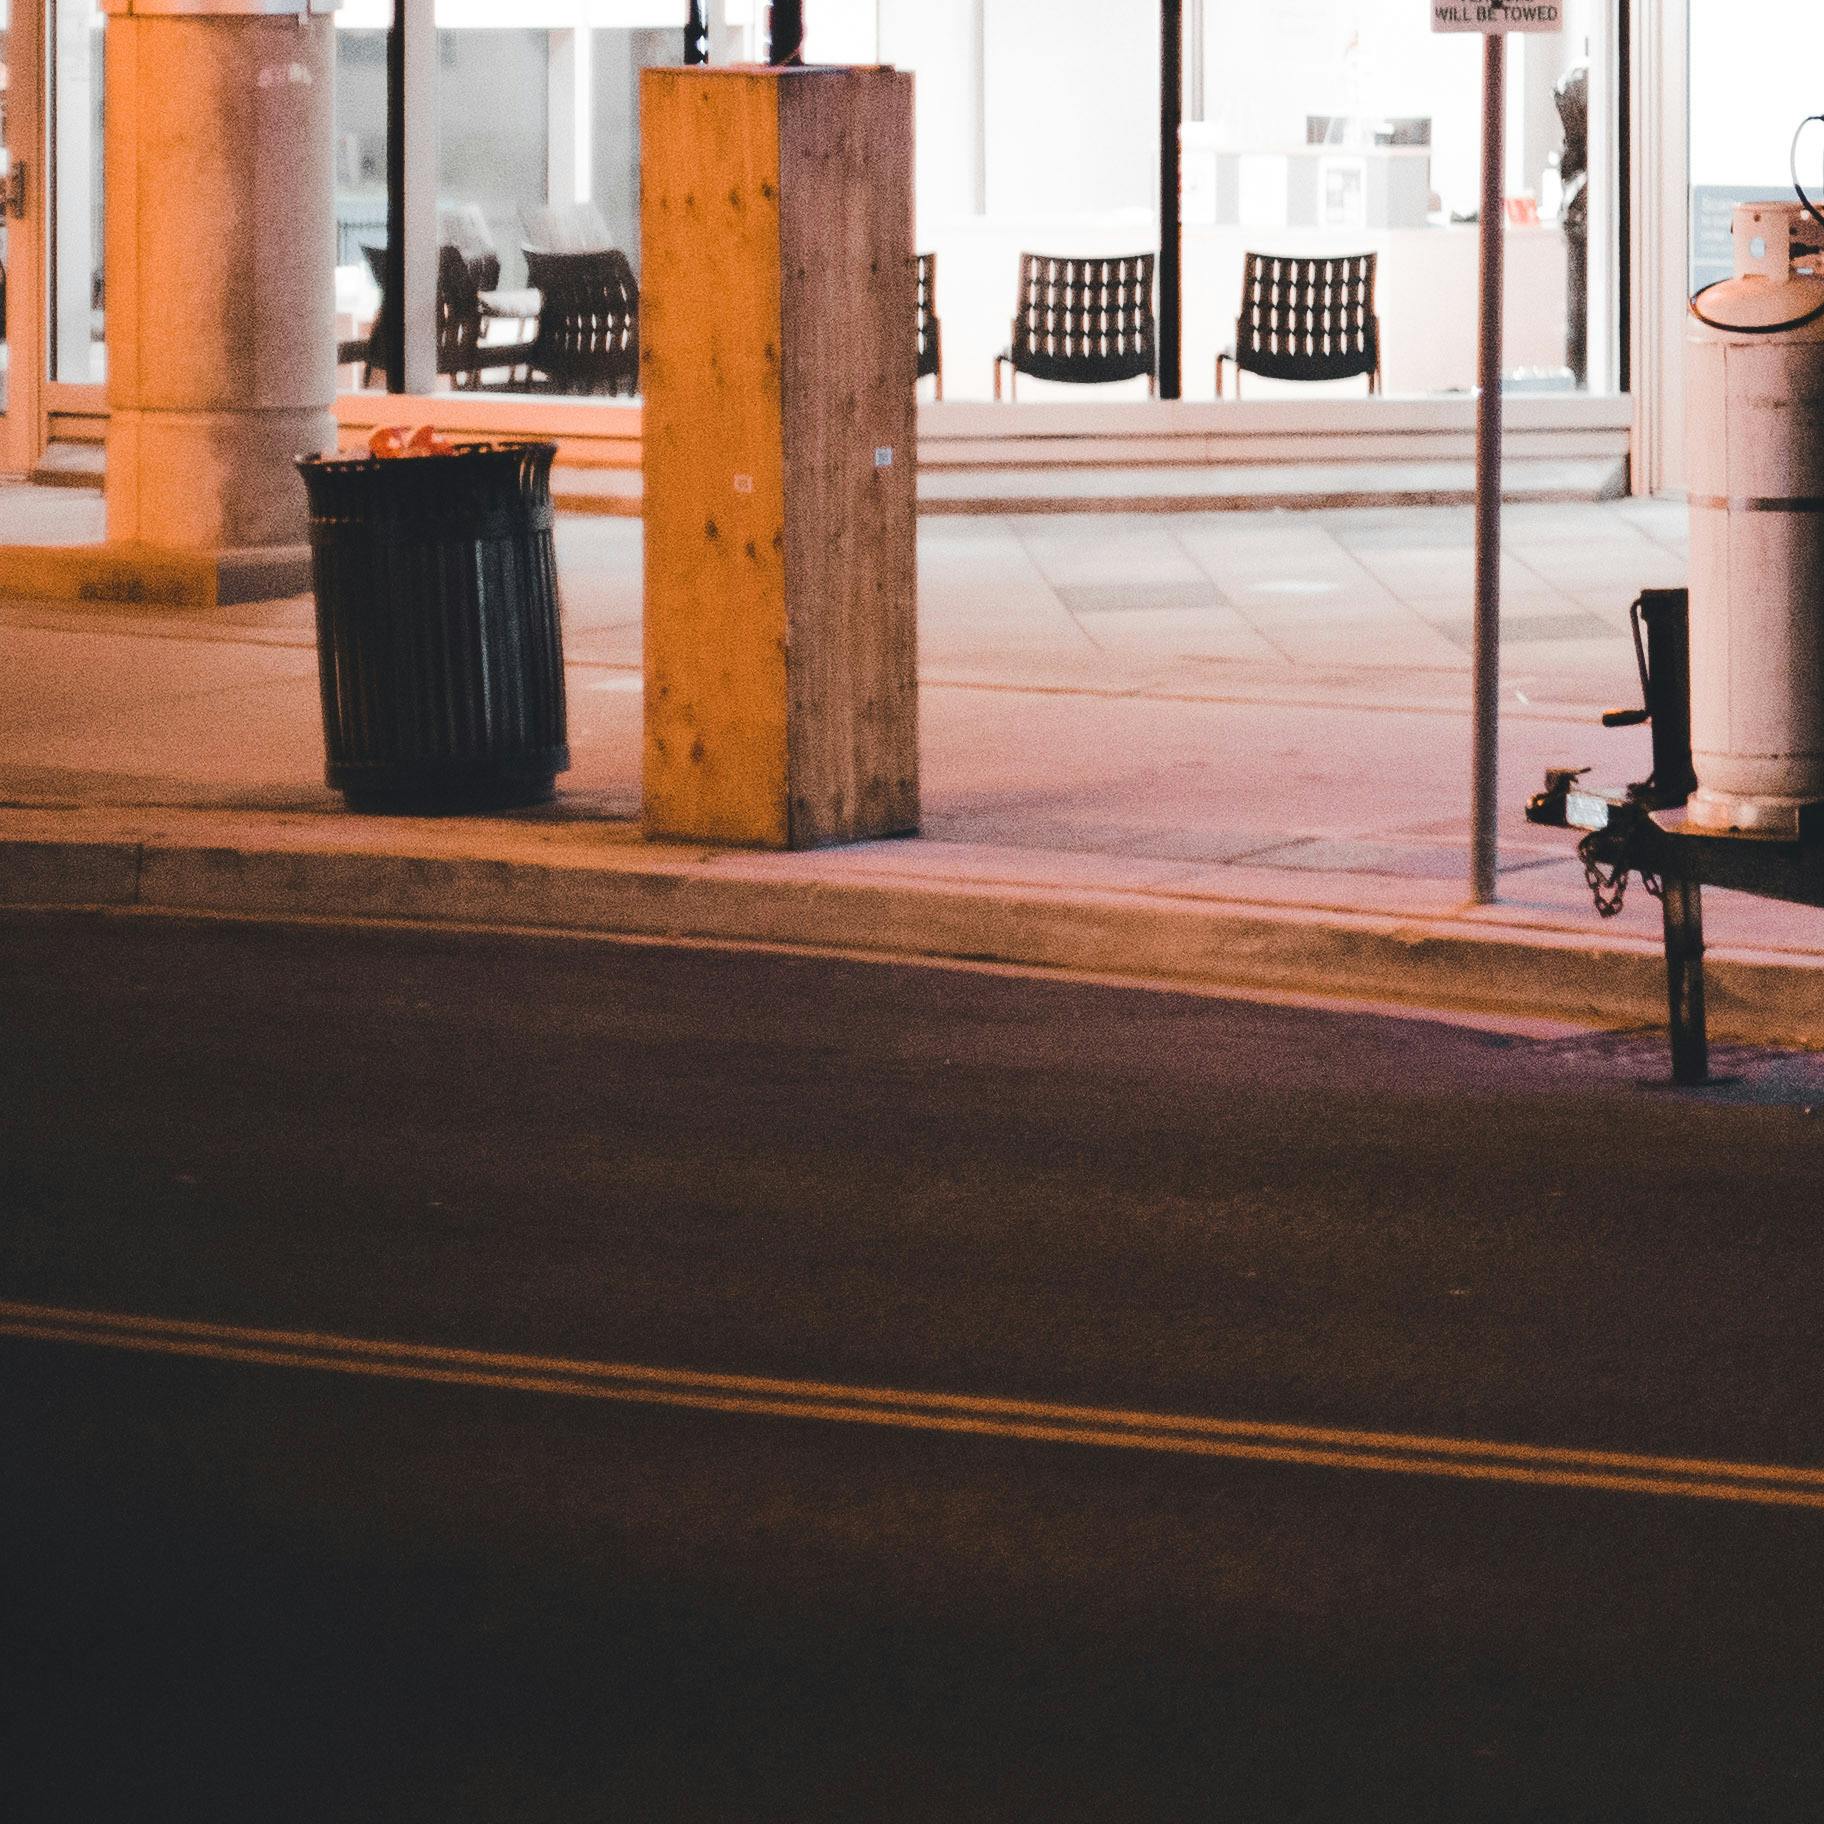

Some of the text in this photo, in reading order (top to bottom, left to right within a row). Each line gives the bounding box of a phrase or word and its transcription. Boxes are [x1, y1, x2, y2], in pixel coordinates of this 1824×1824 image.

[1435, 5, 1558, 23] WILL BE TOWED
